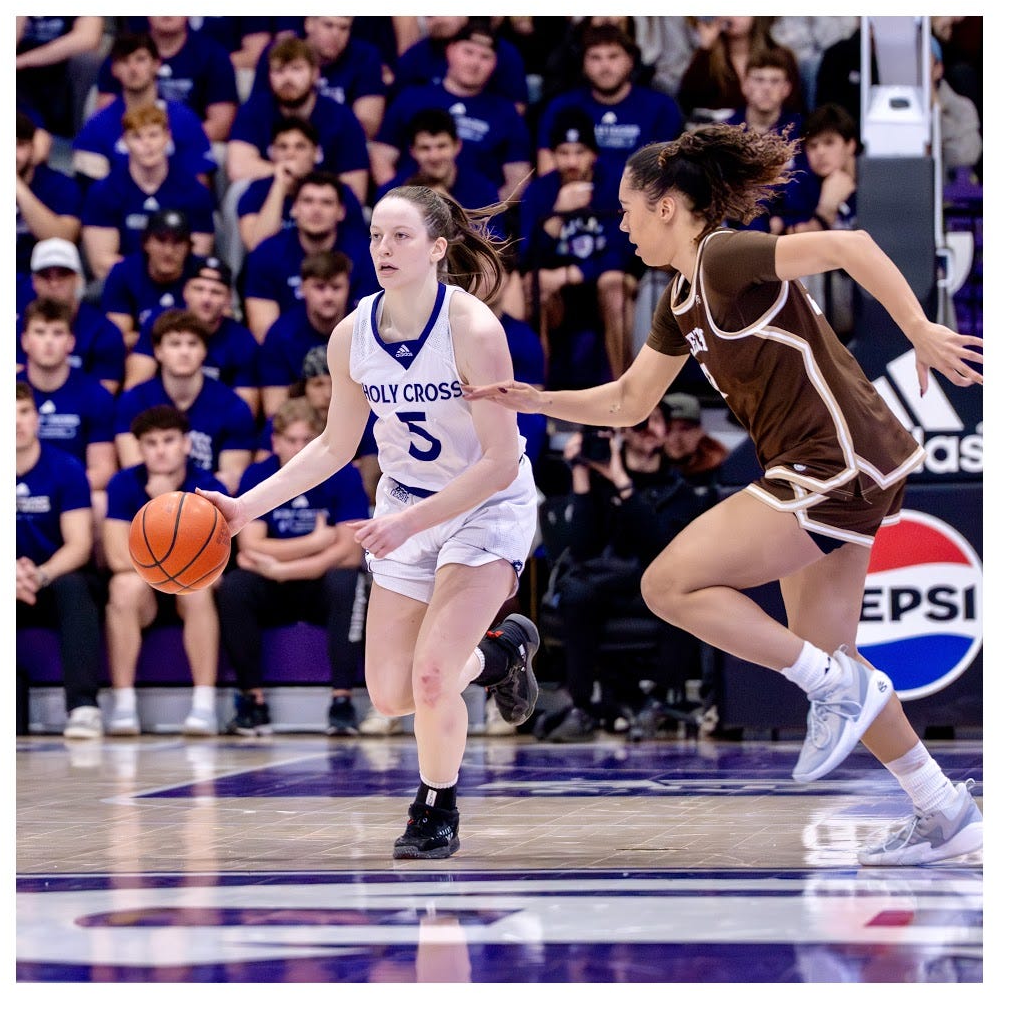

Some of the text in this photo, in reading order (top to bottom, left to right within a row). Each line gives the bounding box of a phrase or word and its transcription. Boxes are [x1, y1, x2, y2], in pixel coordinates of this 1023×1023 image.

[362, 380, 463, 404] HOLY CROSS
[395, 411, 442, 462] 5
[860, 584, 976, 623] EPSI
